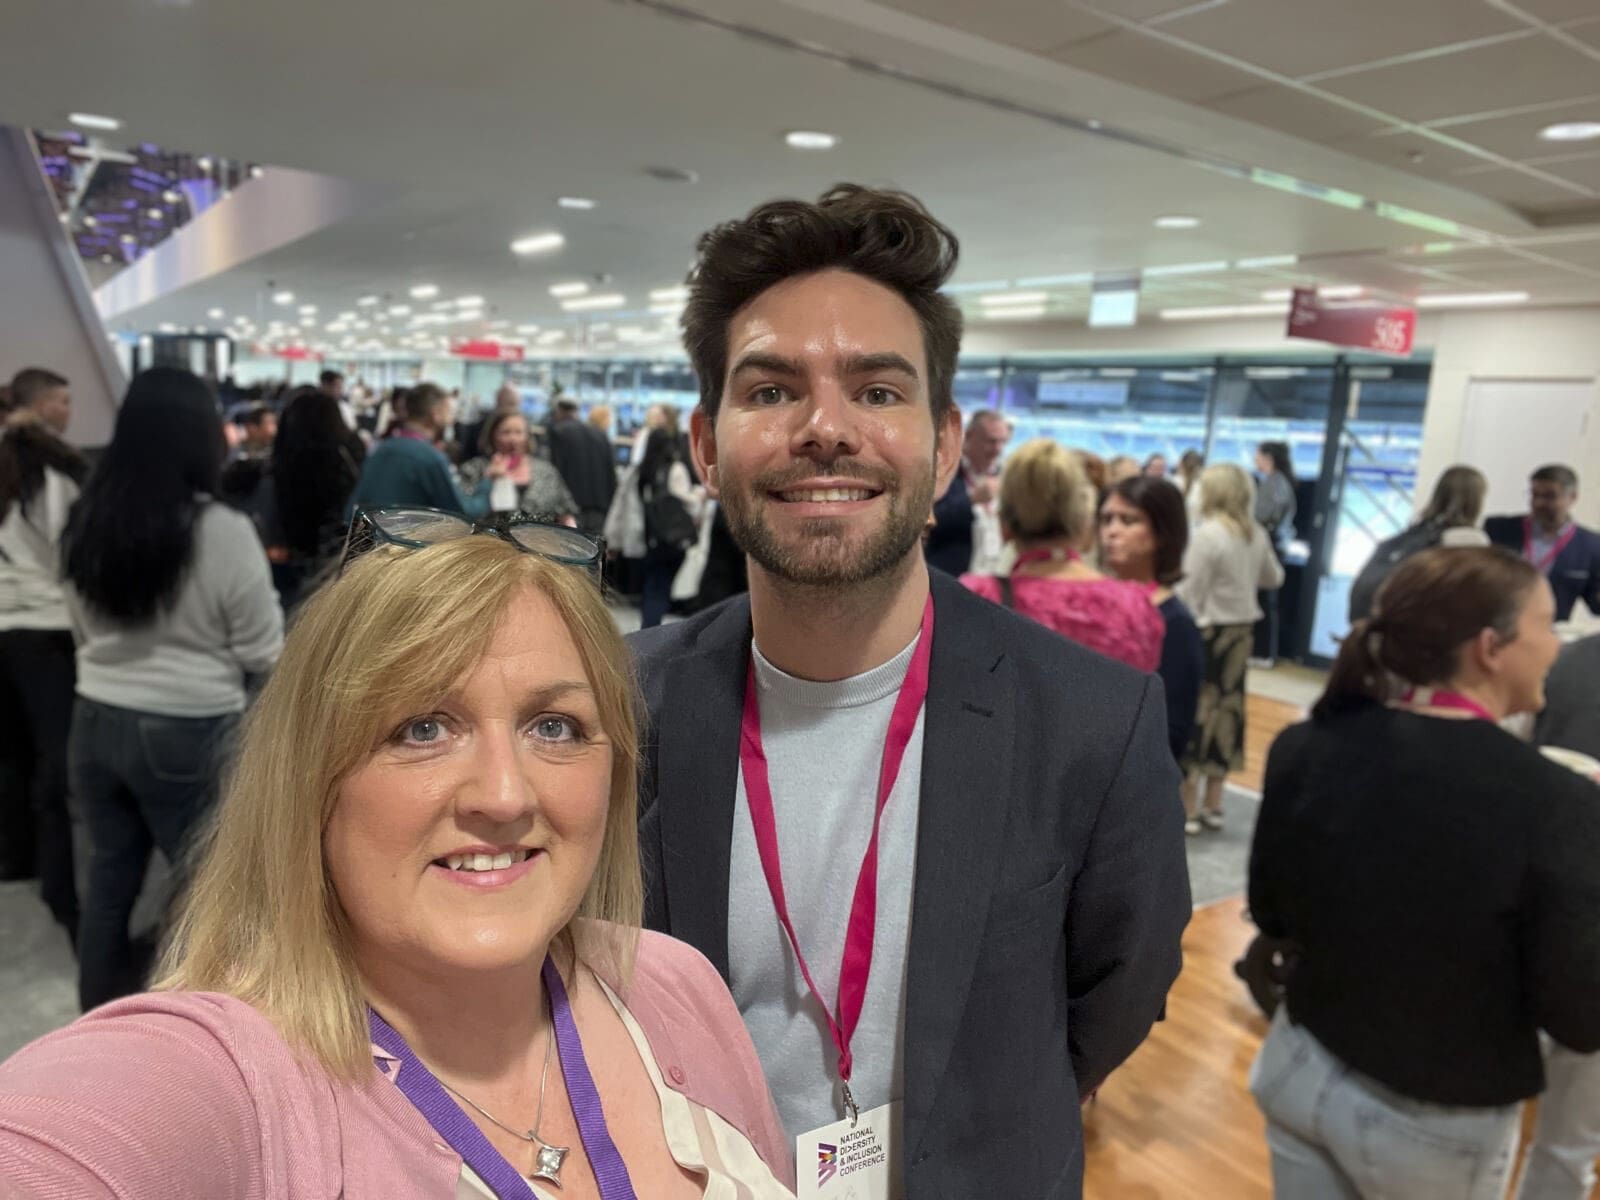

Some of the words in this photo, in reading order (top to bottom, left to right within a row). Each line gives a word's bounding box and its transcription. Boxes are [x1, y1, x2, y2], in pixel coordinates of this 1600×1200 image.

[840, 1126, 874, 1144] NATIONAL
[840, 1157, 846, 1166] &
[847, 1144, 882, 1164] INCLUSION
[840, 1153, 886, 1177] CONFERENCE
